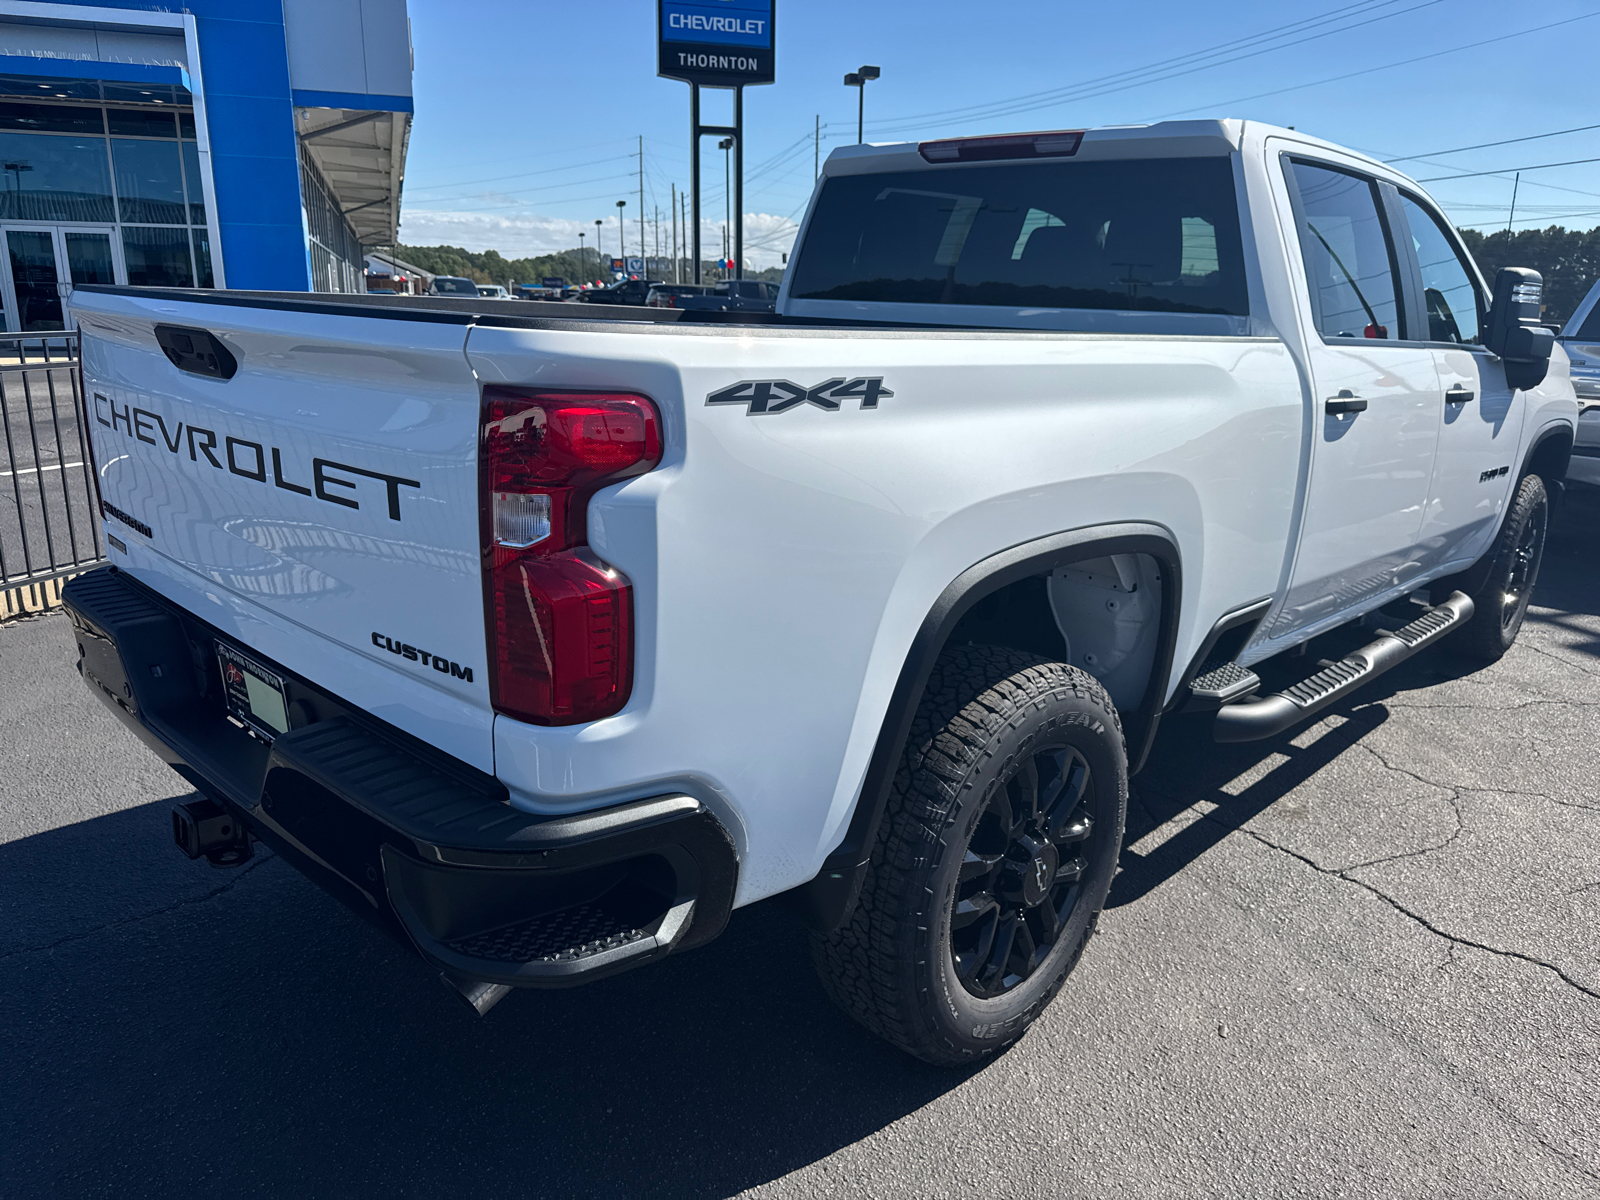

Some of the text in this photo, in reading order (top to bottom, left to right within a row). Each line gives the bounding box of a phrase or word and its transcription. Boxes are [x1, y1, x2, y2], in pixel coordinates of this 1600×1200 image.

[669, 13, 766, 35] CHEVROLET
[678, 52, 758, 71] THORNTON
[93, 392, 421, 522] CHEVROLET
[371, 631, 474, 683] CUSTOM
